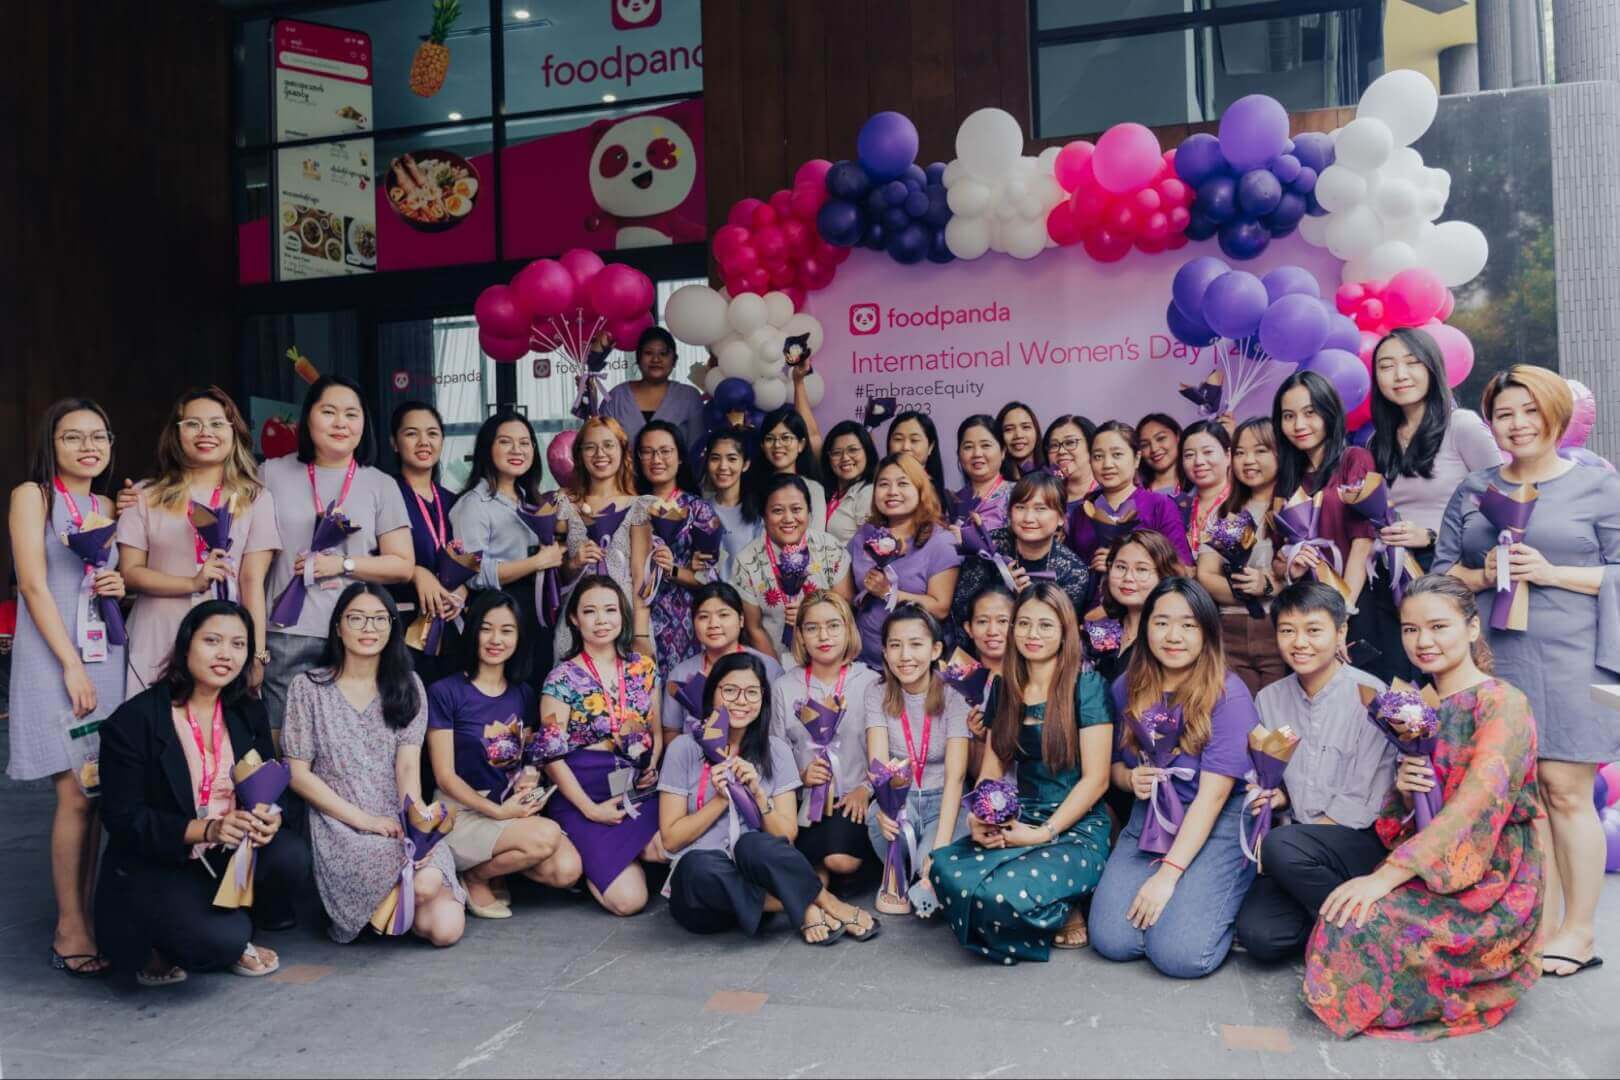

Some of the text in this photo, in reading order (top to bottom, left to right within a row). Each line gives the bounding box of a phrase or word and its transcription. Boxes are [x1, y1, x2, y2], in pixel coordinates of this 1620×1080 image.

[886, 302, 1012, 331] foodpanda
[851, 340, 1011, 375] International
[1018, 336, 1141, 366] Women's
[1149, 334, 1201, 366] Day
[417, 368, 482, 388] dpanda
[855, 379, 985, 399] #EmbraceEquity
[855, 402, 932, 420] #2023
